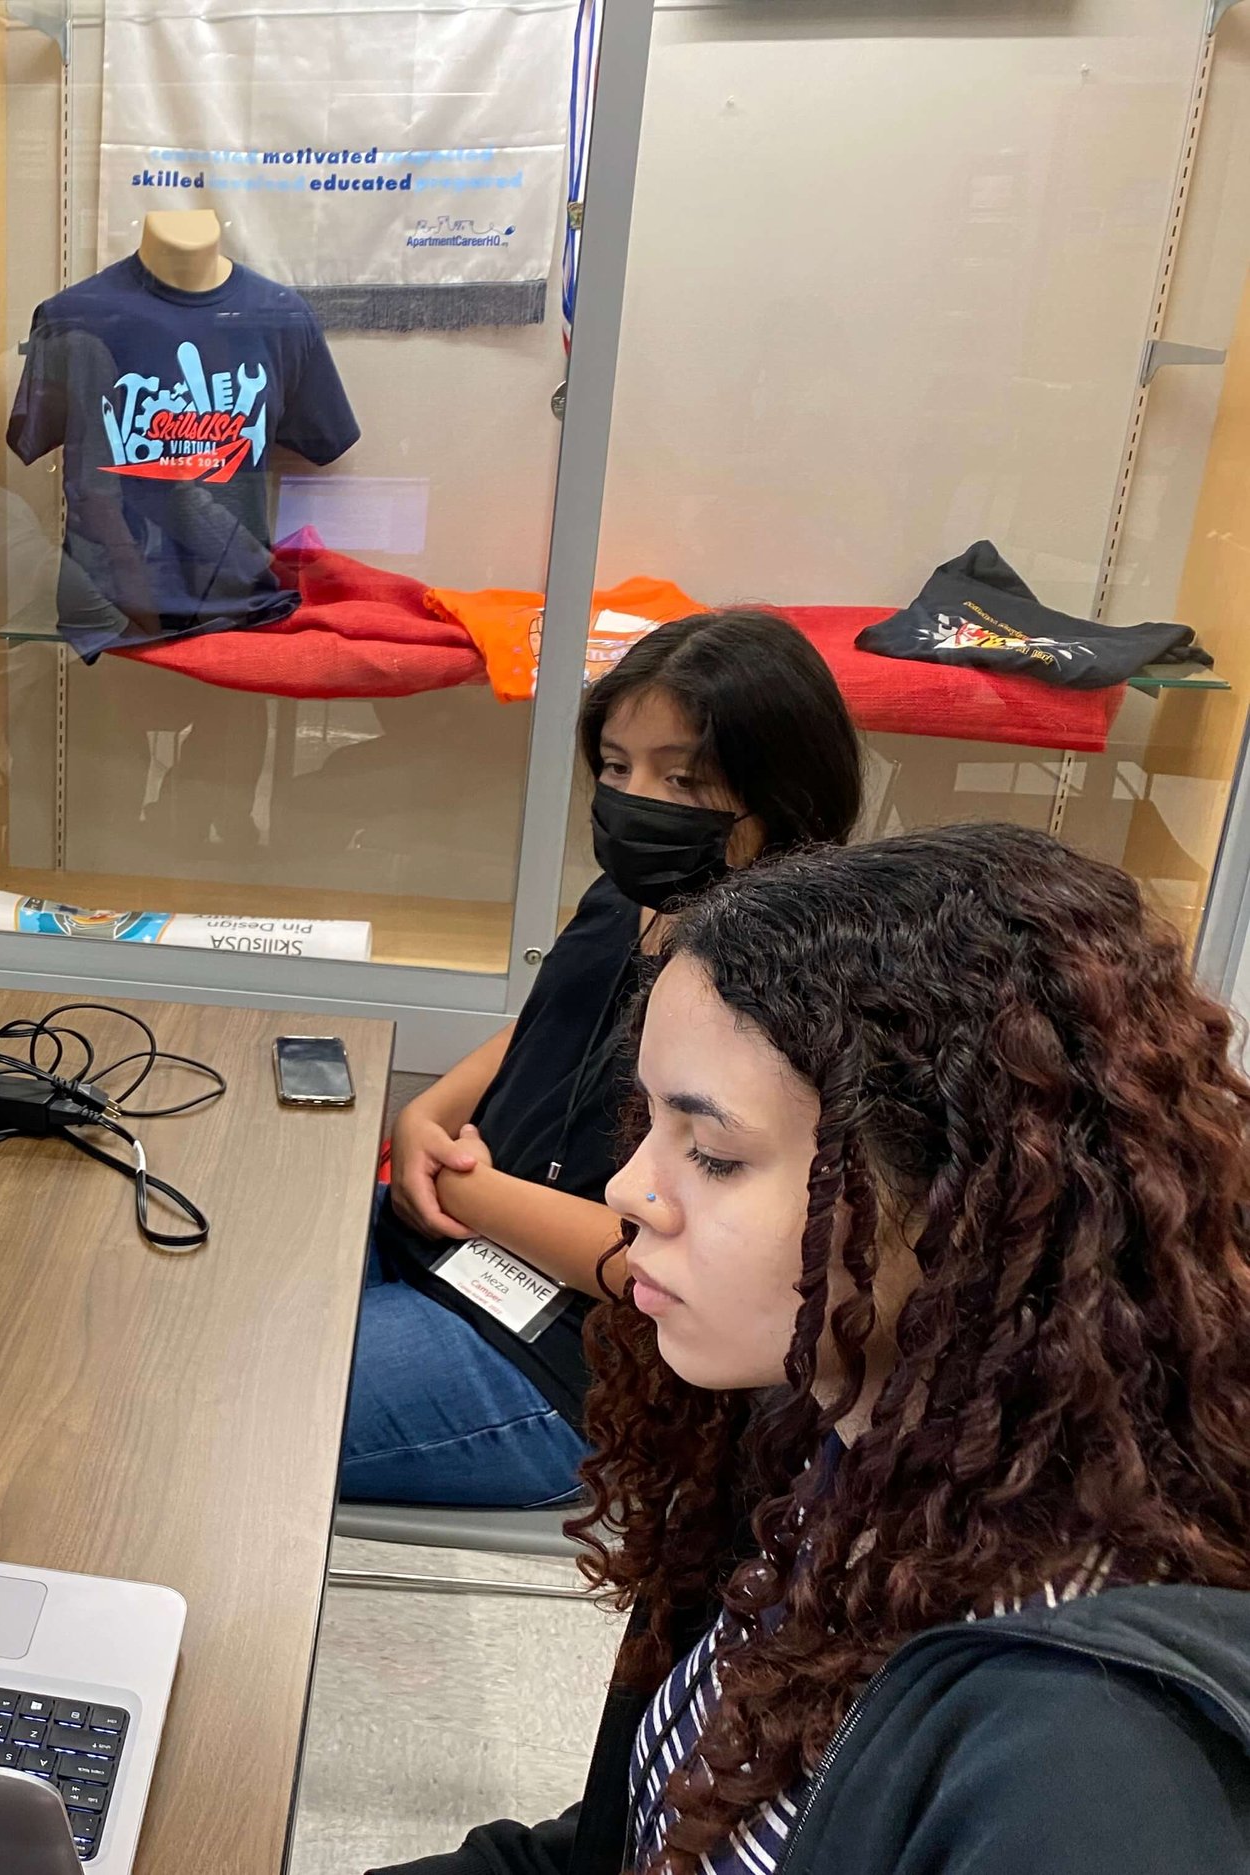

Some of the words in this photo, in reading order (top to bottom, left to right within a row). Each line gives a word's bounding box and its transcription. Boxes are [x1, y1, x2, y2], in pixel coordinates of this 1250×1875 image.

[262, 146, 378, 165] motivated
[131, 170, 205, 188] skilled
[309, 173, 412, 191] educated
[147, 411, 246, 441] SkillsUSA
[170, 440, 218, 456] VIRTUAL
[159, 456, 193, 467] NLSC
[197, 457, 226, 467] 2021
[206, 920, 275, 932] Design
[283, 922, 313, 934] Pin
[210, 935, 303, 956] SkillsUSA
[467, 1239, 552, 1302] KATHERINE
[470, 1279, 503, 1303] Camper
[480, 1271, 510, 1295] Meza
